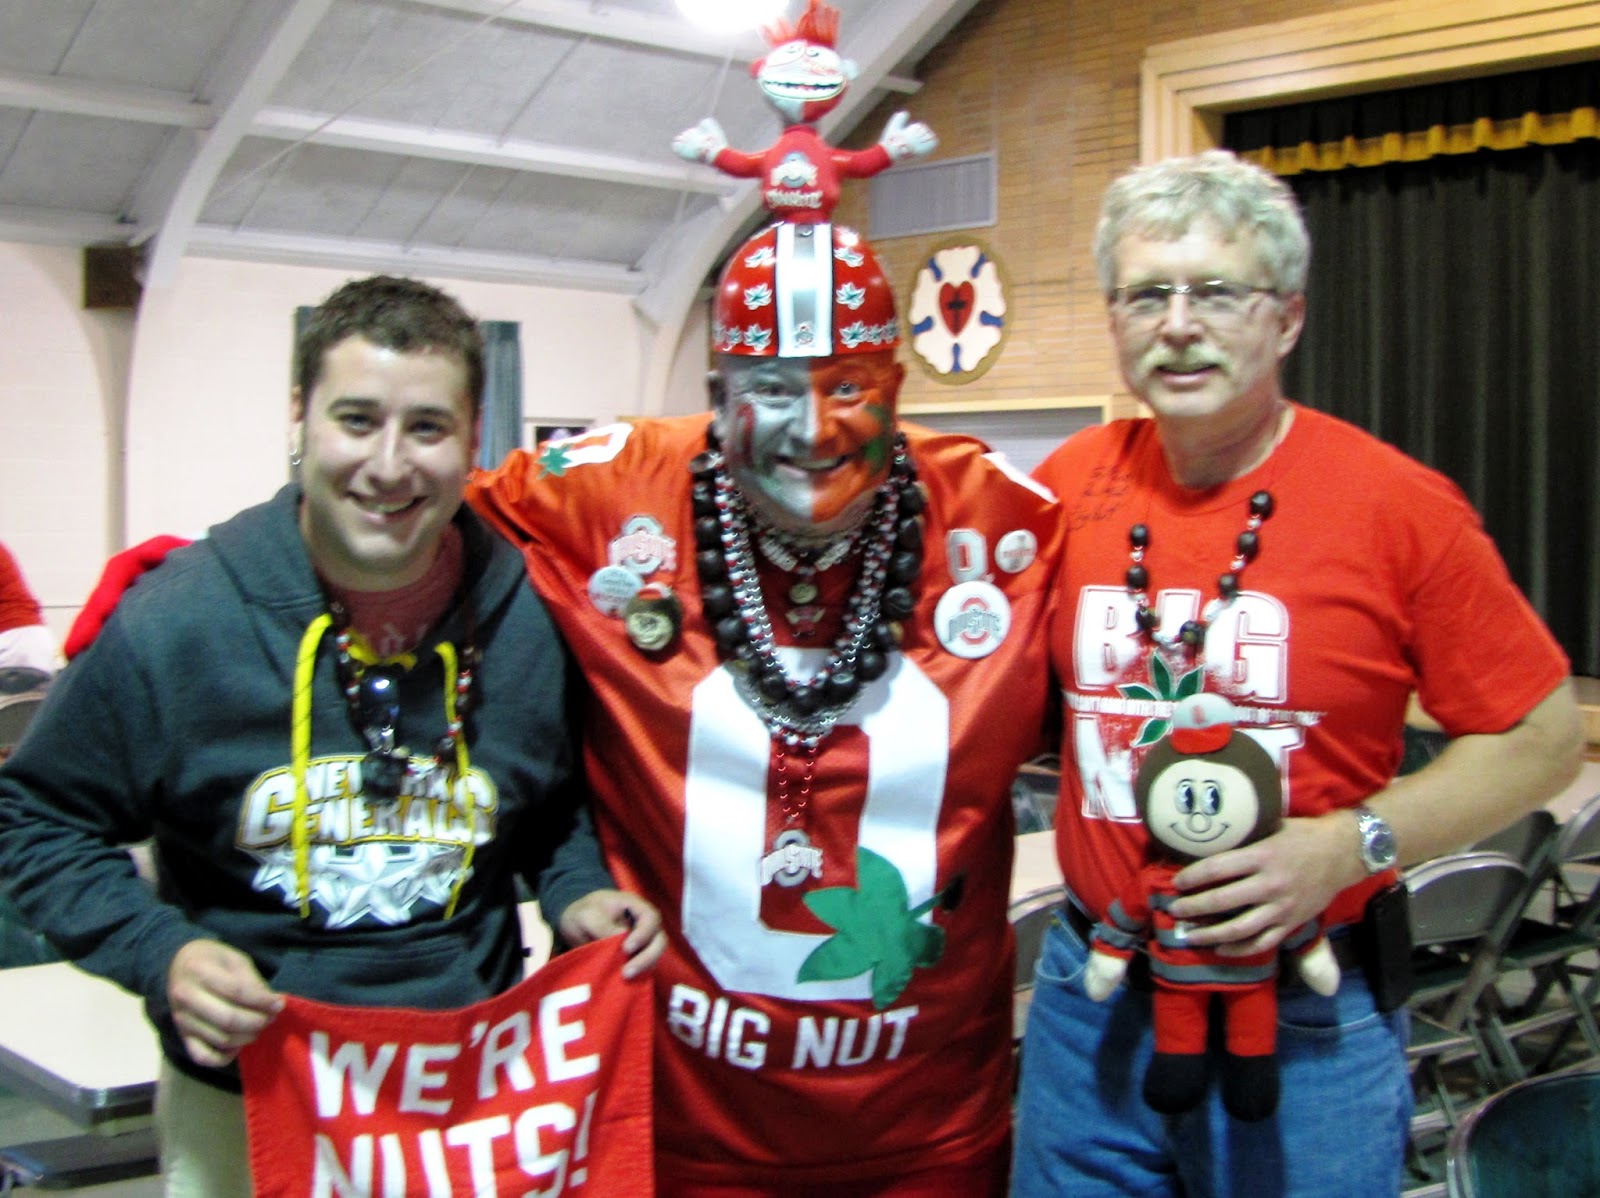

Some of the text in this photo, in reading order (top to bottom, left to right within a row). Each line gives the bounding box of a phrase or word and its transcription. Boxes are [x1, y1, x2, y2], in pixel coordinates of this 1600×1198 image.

[309, 983, 600, 1118] WE'RE
[668, 983, 919, 1070] BIG NUT
[311, 1091, 598, 1198] NUTS!
